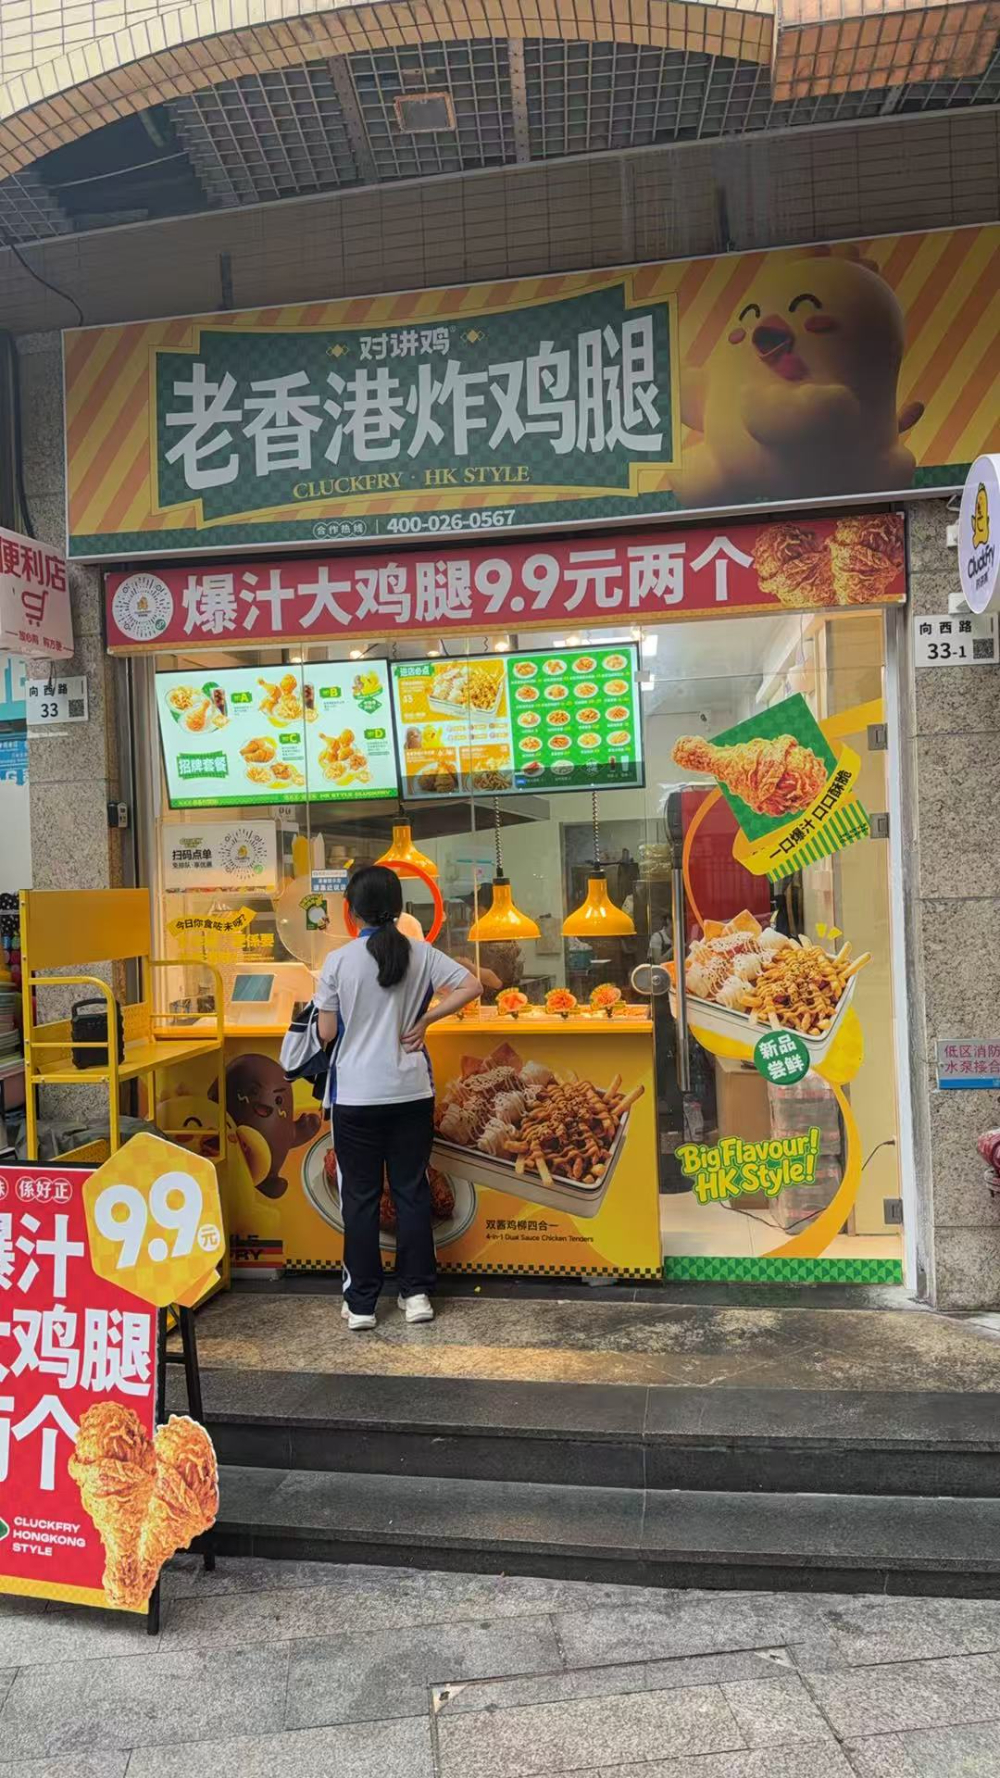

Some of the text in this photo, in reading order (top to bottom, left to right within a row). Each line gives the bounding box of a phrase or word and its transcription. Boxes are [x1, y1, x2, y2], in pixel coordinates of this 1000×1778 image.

[360, 327, 450, 361] 对讲鸡
[164, 315, 664, 491] 老香港炸鸡腿
[292, 466, 530, 499] CLUCKFRY HK STYLE
[316, 523, 364, 536] 合作热线
[386, 509, 516, 534] 400-026-0567
[0, 535, 67, 593] 便利店
[182, 535, 754, 636] 爆汁大鸡腿9.9元两个
[919, 620, 972, 636] 向西路
[927, 642, 967, 660] 33-1
[29, 683, 68, 698] 向西路
[40, 702, 59, 718] 33
[769, 769, 853, 860] 一口爆汁 口口酥脆
[172, 848, 213, 861] 扫码点单
[758, 1032, 798, 1062] 新品
[944, 1044, 1000, 1059] 低区消防
[767, 1053, 806, 1082] 尝鲜
[945, 1060, 1000, 1075] 水泵接合
[719, 1126, 821, 1167] Flavour!
[19, 1180, 69, 1199] 係好正
[694, 1154, 817, 1205] HK Style!
[94, 1171, 218, 1270] 9.9 元
[485, 1219, 559, 1231] 双酱鸡柳四合一
[541, 1234, 567, 1242] Chicken
[569, 1235, 594, 1243] Tenders
[0, 1213, 85, 1298] 汁
[0, 1304, 151, 1396] 鸡腿
[0, 1394, 80, 1491] 个
[13, 1516, 81, 1532] CLUCKFRY
[12, 1529, 86, 1548] HONGKONG
[12, 1542, 53, 1557] STYLE
